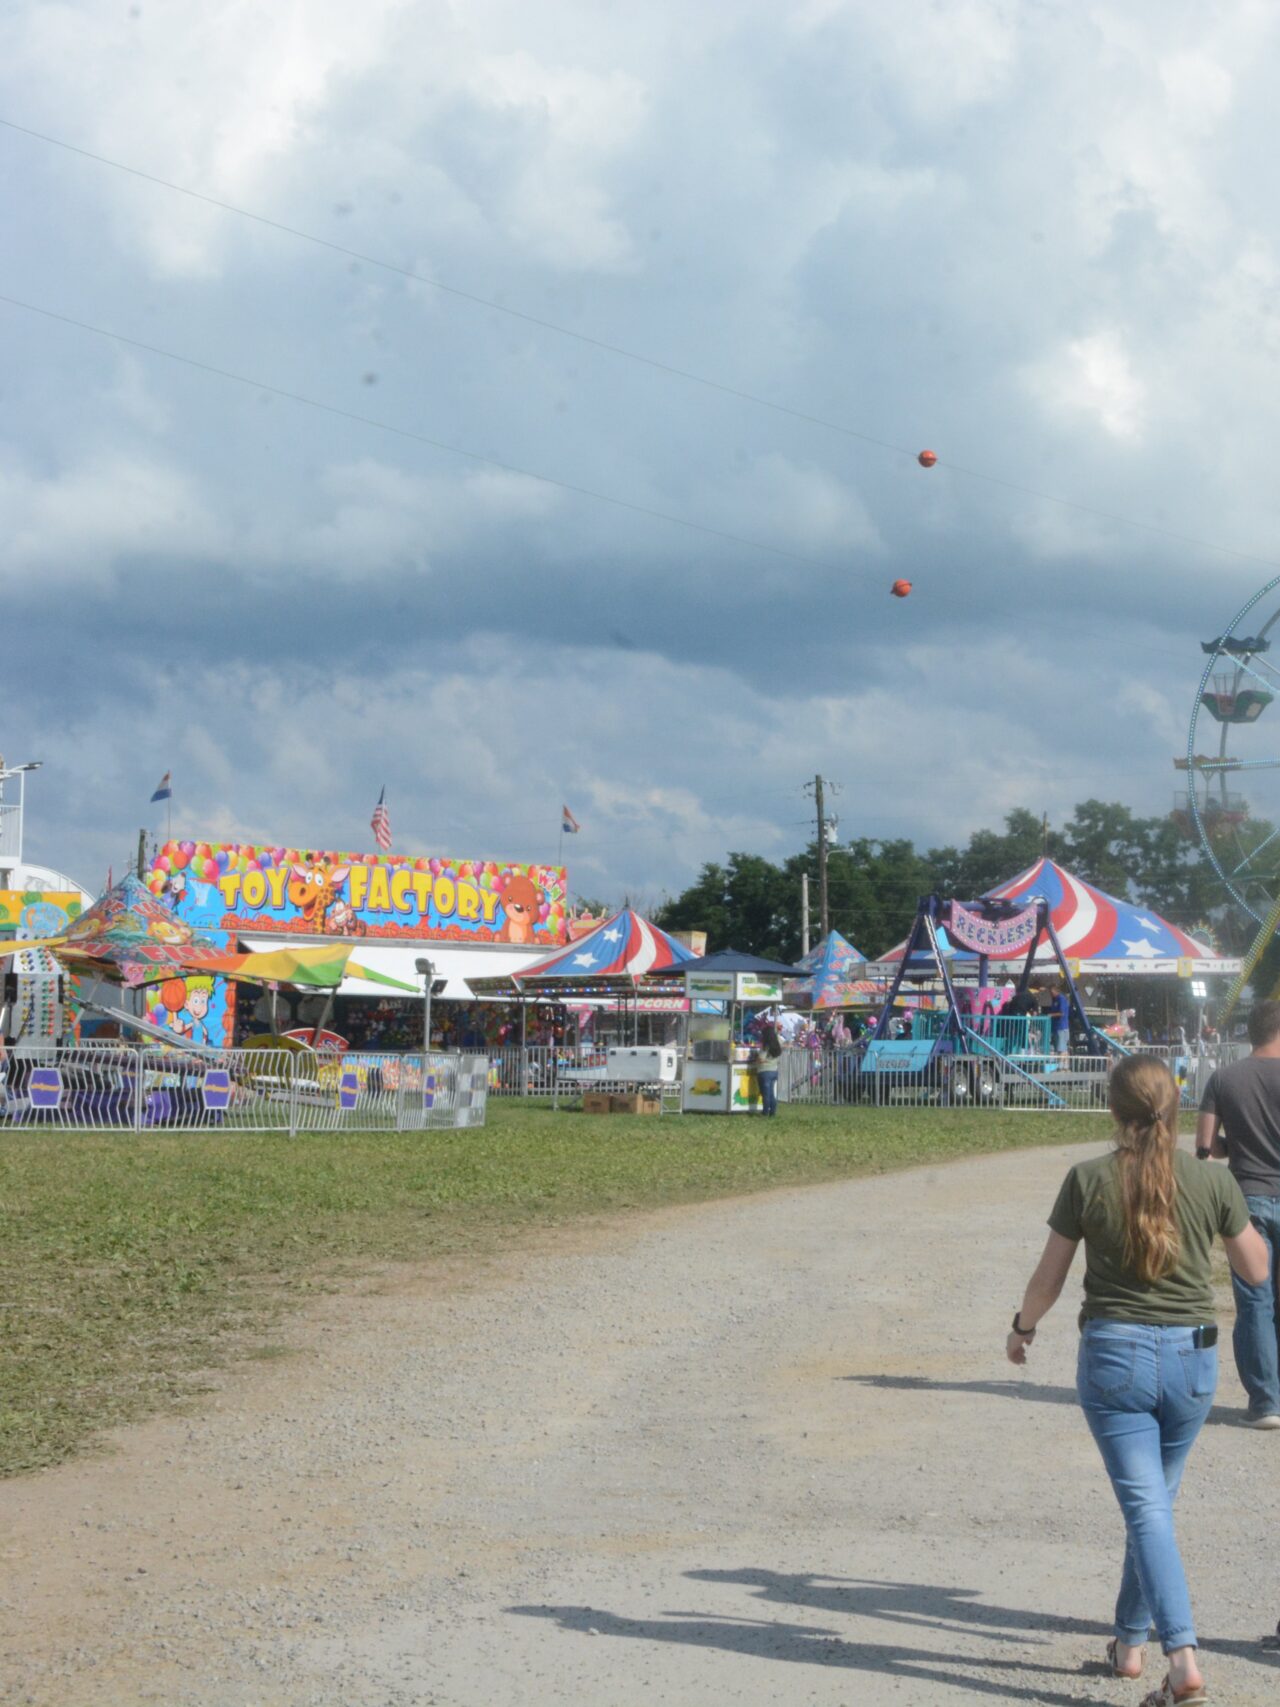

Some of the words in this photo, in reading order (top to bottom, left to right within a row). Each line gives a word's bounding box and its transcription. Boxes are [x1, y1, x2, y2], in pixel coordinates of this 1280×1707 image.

[218, 866, 292, 911] TOY
[348, 863, 502, 923] FACTORY
[956, 913, 1034, 946] RECKLESS
[616, 998, 685, 1010] OPCORN
